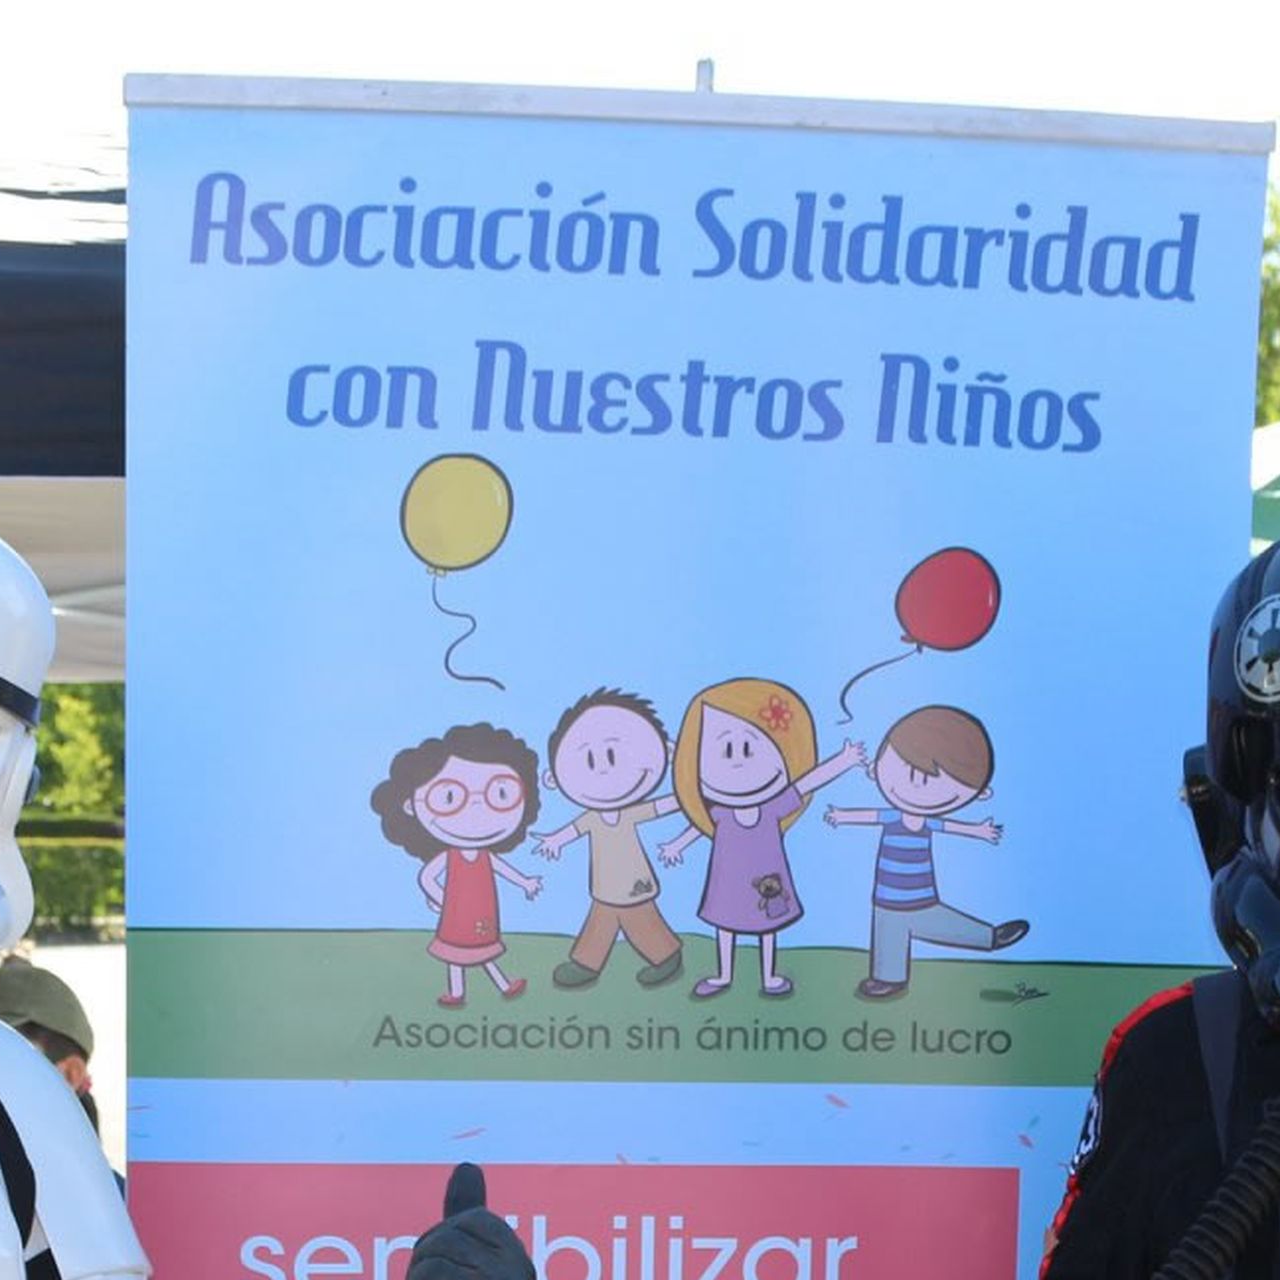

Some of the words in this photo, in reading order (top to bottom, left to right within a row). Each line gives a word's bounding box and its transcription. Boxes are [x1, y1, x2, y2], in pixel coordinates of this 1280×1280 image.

[190, 172, 660, 277] Asociación
[693, 188, 1200, 302] Solidaridad
[287, 363, 439, 430] con
[473, 340, 845, 442] Nuestros
[876, 354, 1102, 454] Niños
[372, 1015, 611, 1050] Asociación
[625, 1017, 681, 1051] sin
[696, 1016, 828, 1052] ánimo
[841, 1020, 896, 1053] de
[911, 1021, 1013, 1055] lucro
